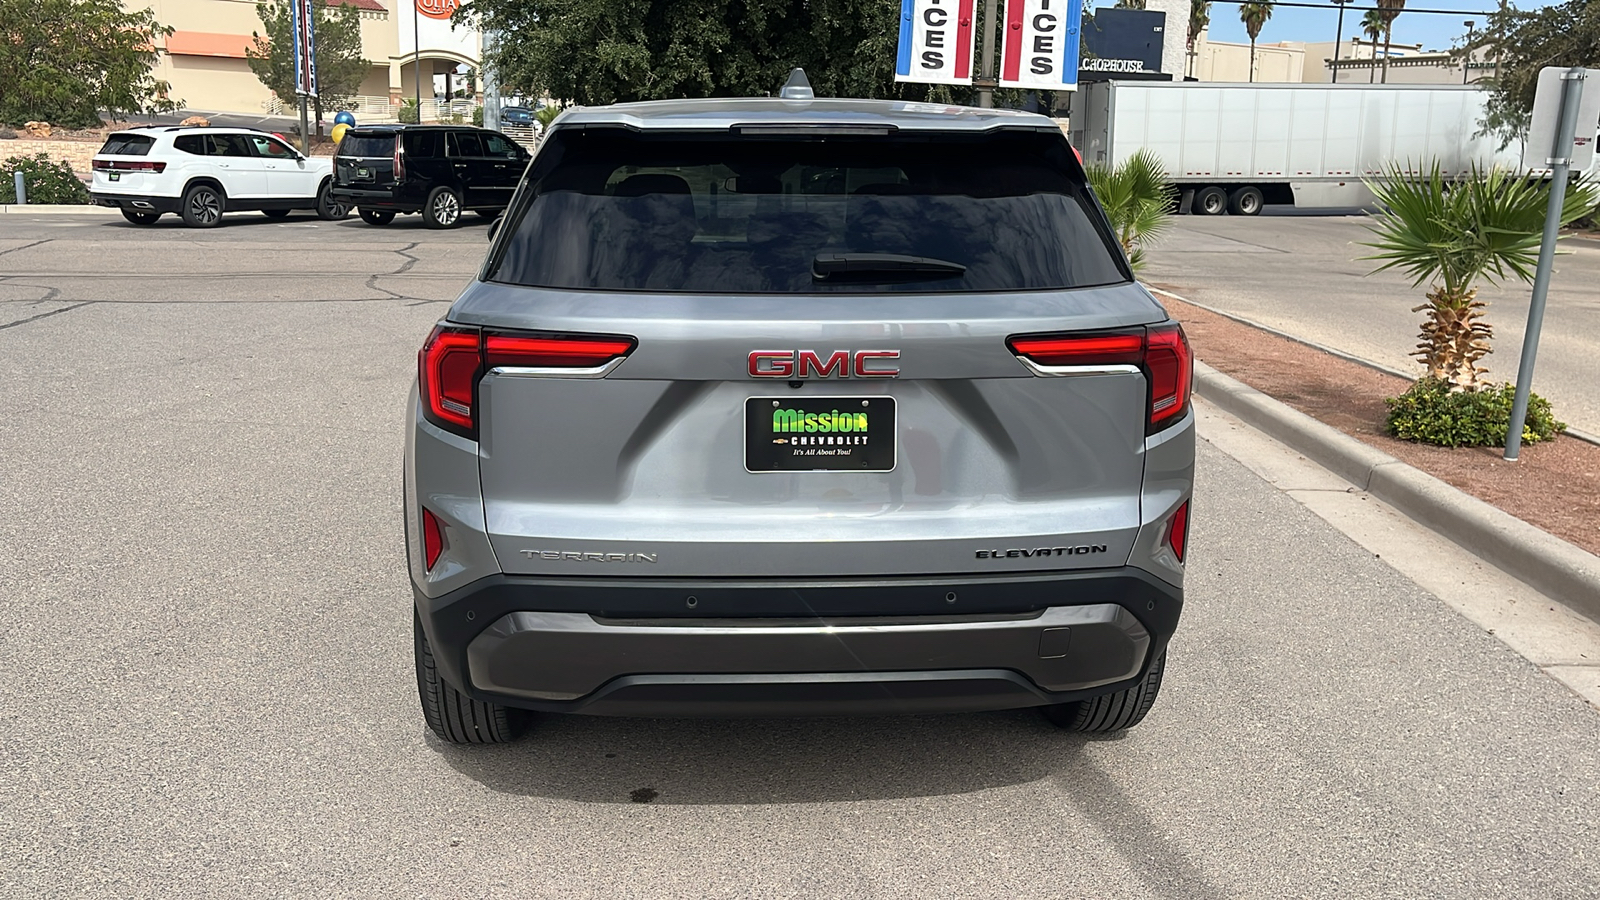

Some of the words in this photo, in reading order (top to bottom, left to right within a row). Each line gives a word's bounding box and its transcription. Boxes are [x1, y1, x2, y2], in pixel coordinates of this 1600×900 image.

[748, 349, 901, 378] GMC
[772, 408, 868, 433] Mission
[791, 436, 869, 446] CHEVROLET
[519, 549, 659, 564] TERRAIN
[975, 544, 1108, 559] ELEVATION
